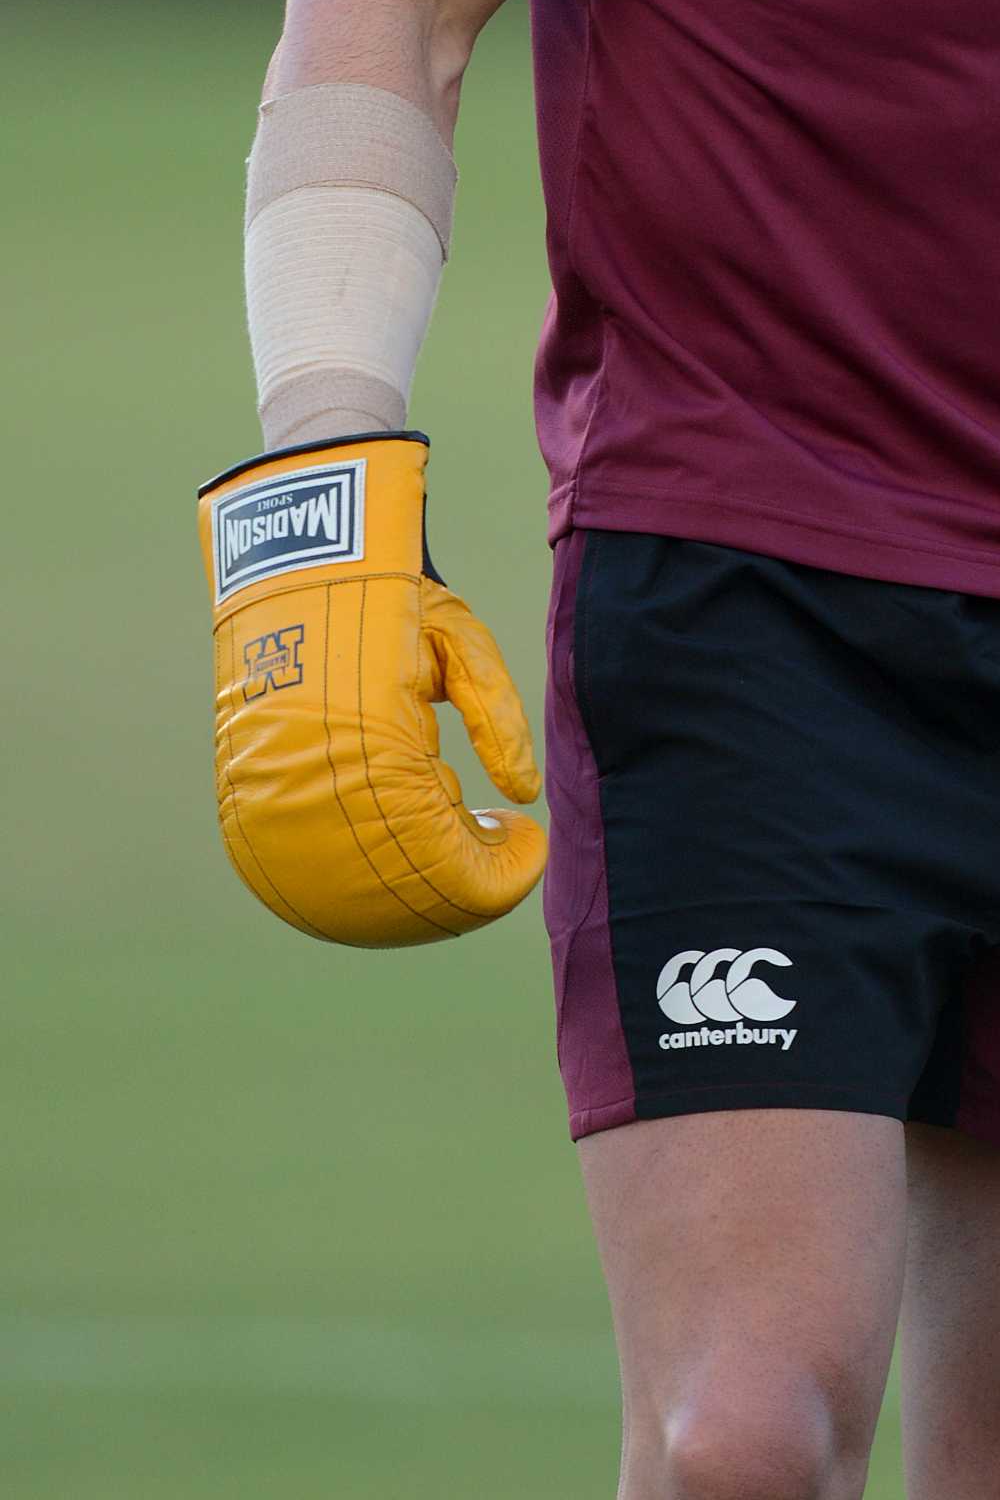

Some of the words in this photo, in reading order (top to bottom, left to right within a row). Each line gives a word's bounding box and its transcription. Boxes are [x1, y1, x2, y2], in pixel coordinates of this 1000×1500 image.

[255, 492, 294, 513] SPORT
[225, 486, 338, 570] MADISON
[658, 1021, 798, 1051] canterbury
